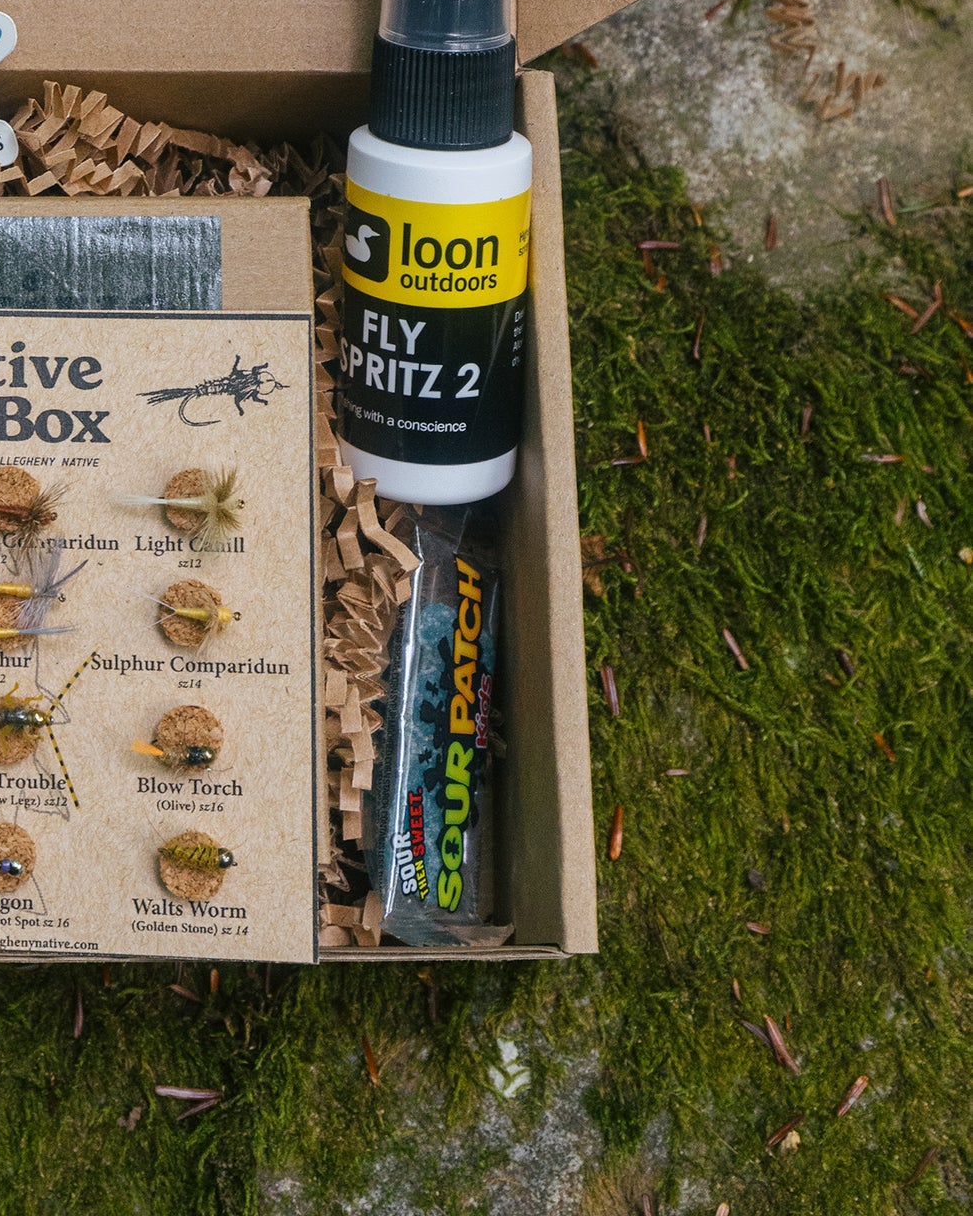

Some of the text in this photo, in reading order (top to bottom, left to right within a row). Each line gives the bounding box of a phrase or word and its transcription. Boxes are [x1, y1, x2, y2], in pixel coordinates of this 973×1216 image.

[401, 222, 499, 270] loon
[400, 271, 498, 292] outdoors
[363, 309, 426, 355] FLY
[340, 336, 480, 399] SPRITZ 2
[363, 409, 384, 424] with
[387, 417, 395, 426] a
[397, 419, 467, 433] conscience
[62, 457, 100, 467] NATIVE
[135, 535, 183, 556] Light
[178, 559, 202, 569] sz12
[91, 654, 290, 678] Sulphur Comparidun
[178, 679, 202, 689] sz14
[475, 674, 492, 749] Kids
[438, 557, 482, 912] SOUR PATCH
[137, 776, 243, 796] Blow Torch
[11, 794, 41, 808] Legz)
[44, 797, 68, 807] sz12
[156, 800, 224, 813] (Olive) sz16
[409, 787, 429, 900] THEN SWEET.
[394, 831, 418, 894] SOUR
[132, 898, 247, 919] Walts Worm
[15, 915, 40, 929] Spot
[57, 918, 69, 928] 16
[131, 920, 249, 936] (Golden Stone) sz 14
